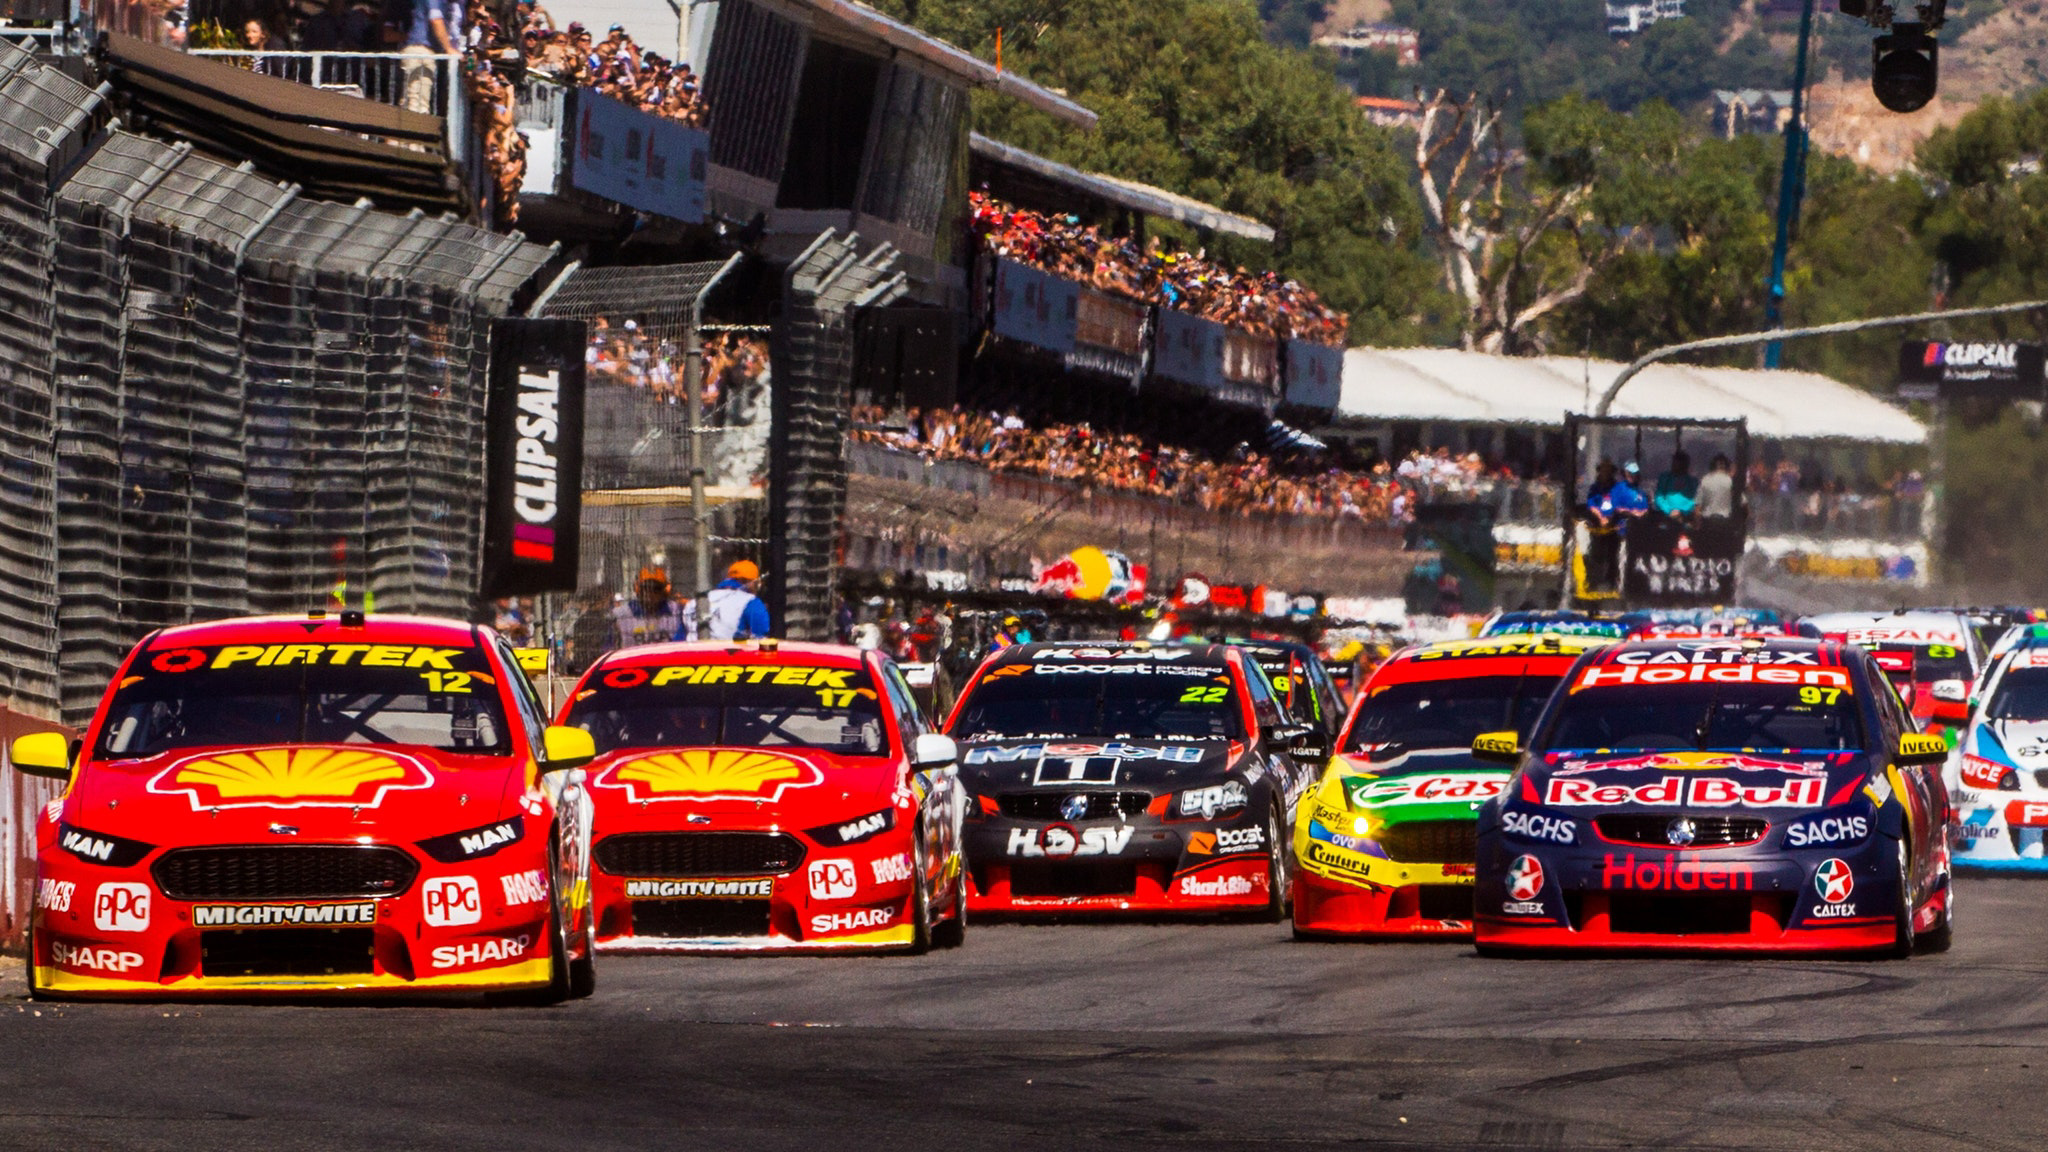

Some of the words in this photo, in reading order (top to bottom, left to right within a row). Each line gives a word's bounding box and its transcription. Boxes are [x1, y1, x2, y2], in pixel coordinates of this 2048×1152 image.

[1944, 342, 2018, 368] CLIPSAL
[514, 370, 559, 523] CLIPSAL
[210, 644, 464, 670] PIRTEK
[1034, 663, 1152, 675] boost
[420, 671, 472, 692] 12
[652, 666, 856, 688] PIRTEK
[1582, 664, 1848, 685] Holden
[816, 688, 858, 707] 17
[1180, 686, 1228, 703] 22
[1799, 686, 1841, 706] 97
[964, 742, 1205, 764] Mobil
[1474, 738, 1516, 752] IVECO
[1903, 740, 1944, 753] IVECO
[1545, 777, 1684, 806] Red
[1687, 777, 1828, 807] Bull
[460, 824, 516, 854] MAN
[838, 813, 886, 841] MAN
[1216, 824, 1265, 846] boost
[1502, 811, 1576, 845] SACHS
[1787, 816, 1868, 846] SACHS
[63, 831, 115, 861] MAN
[1309, 843, 1370, 876] Century
[811, 864, 853, 895] PPG
[1603, 854, 1753, 890] Holden
[97, 888, 146, 926] PPG
[427, 882, 477, 921] PPG
[1813, 903, 1856, 917] CALTEX
[811, 906, 894, 933] SHARP
[52, 941, 144, 972] SHARP
[432, 934, 530, 968] SHARP
